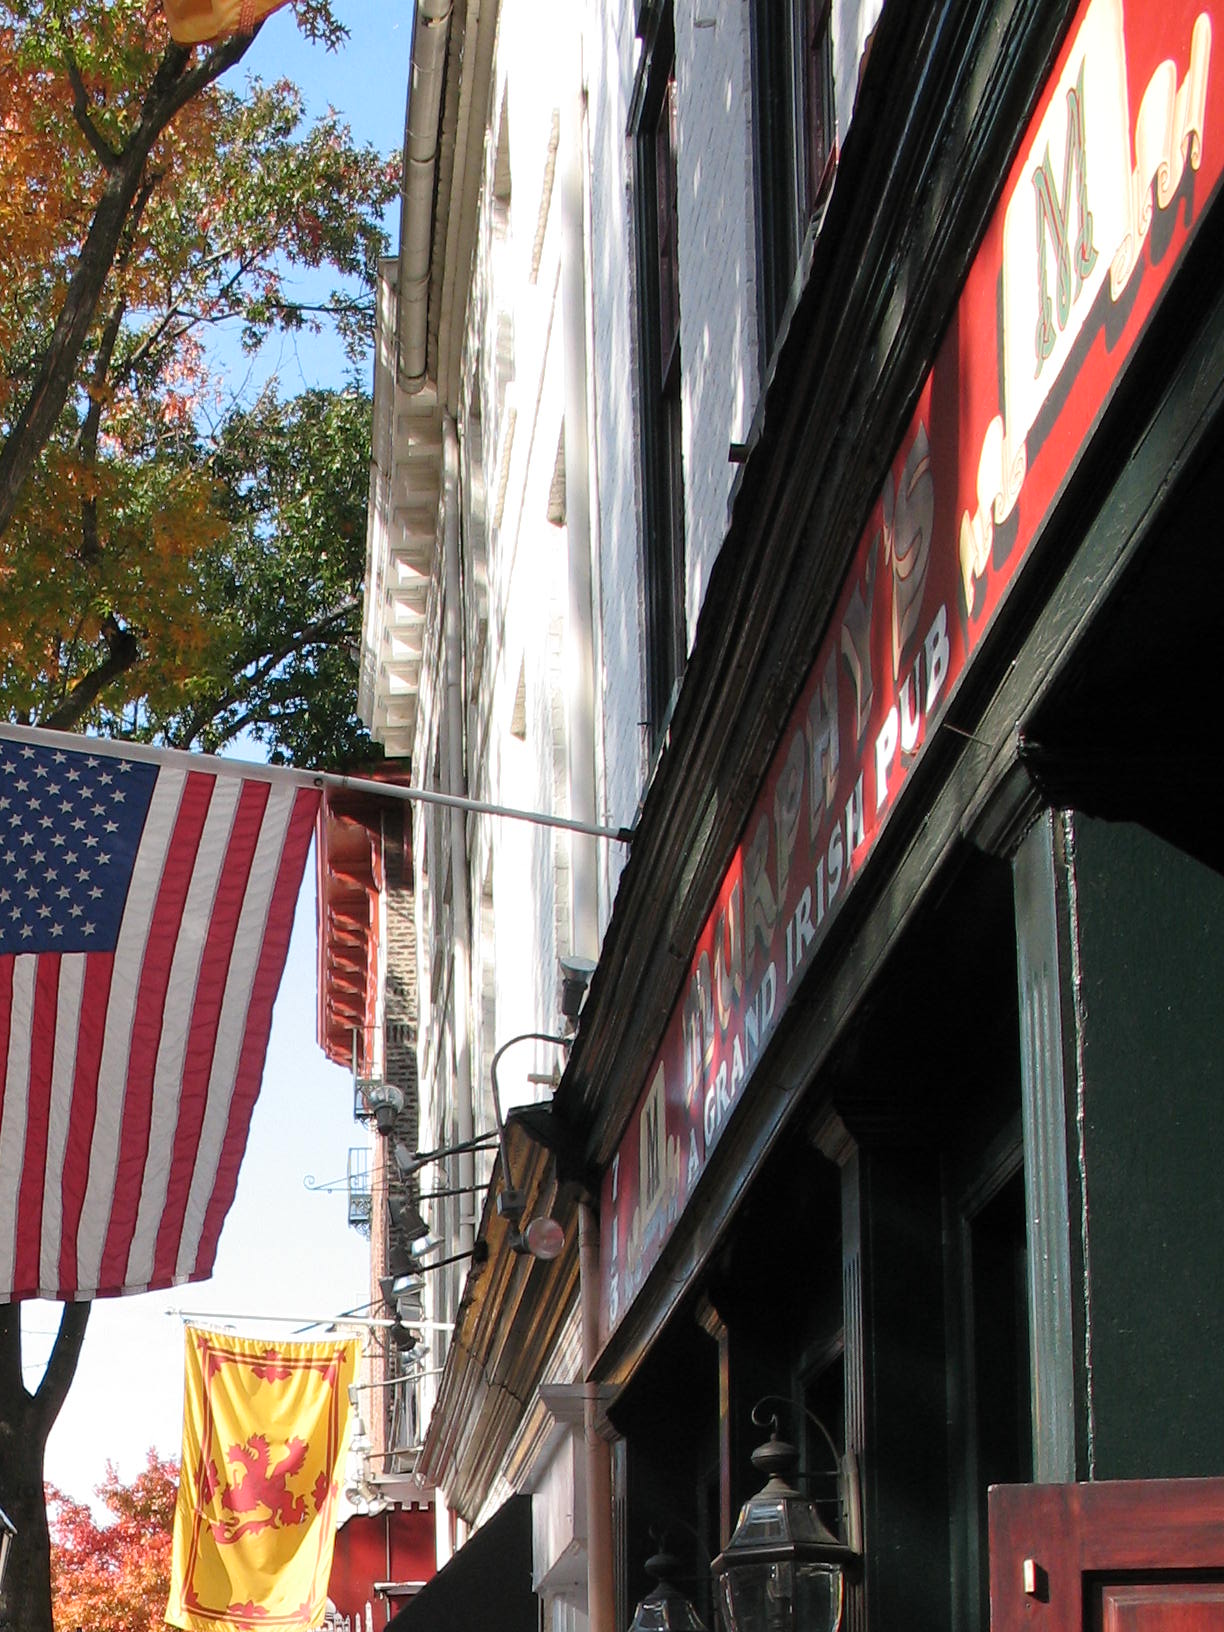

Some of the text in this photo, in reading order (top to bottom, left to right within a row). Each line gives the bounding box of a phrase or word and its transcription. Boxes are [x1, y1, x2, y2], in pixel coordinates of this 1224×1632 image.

[1033, 53, 1099, 379] M
[686, 604, 951, 1183] A GRAND IRISH PUB
